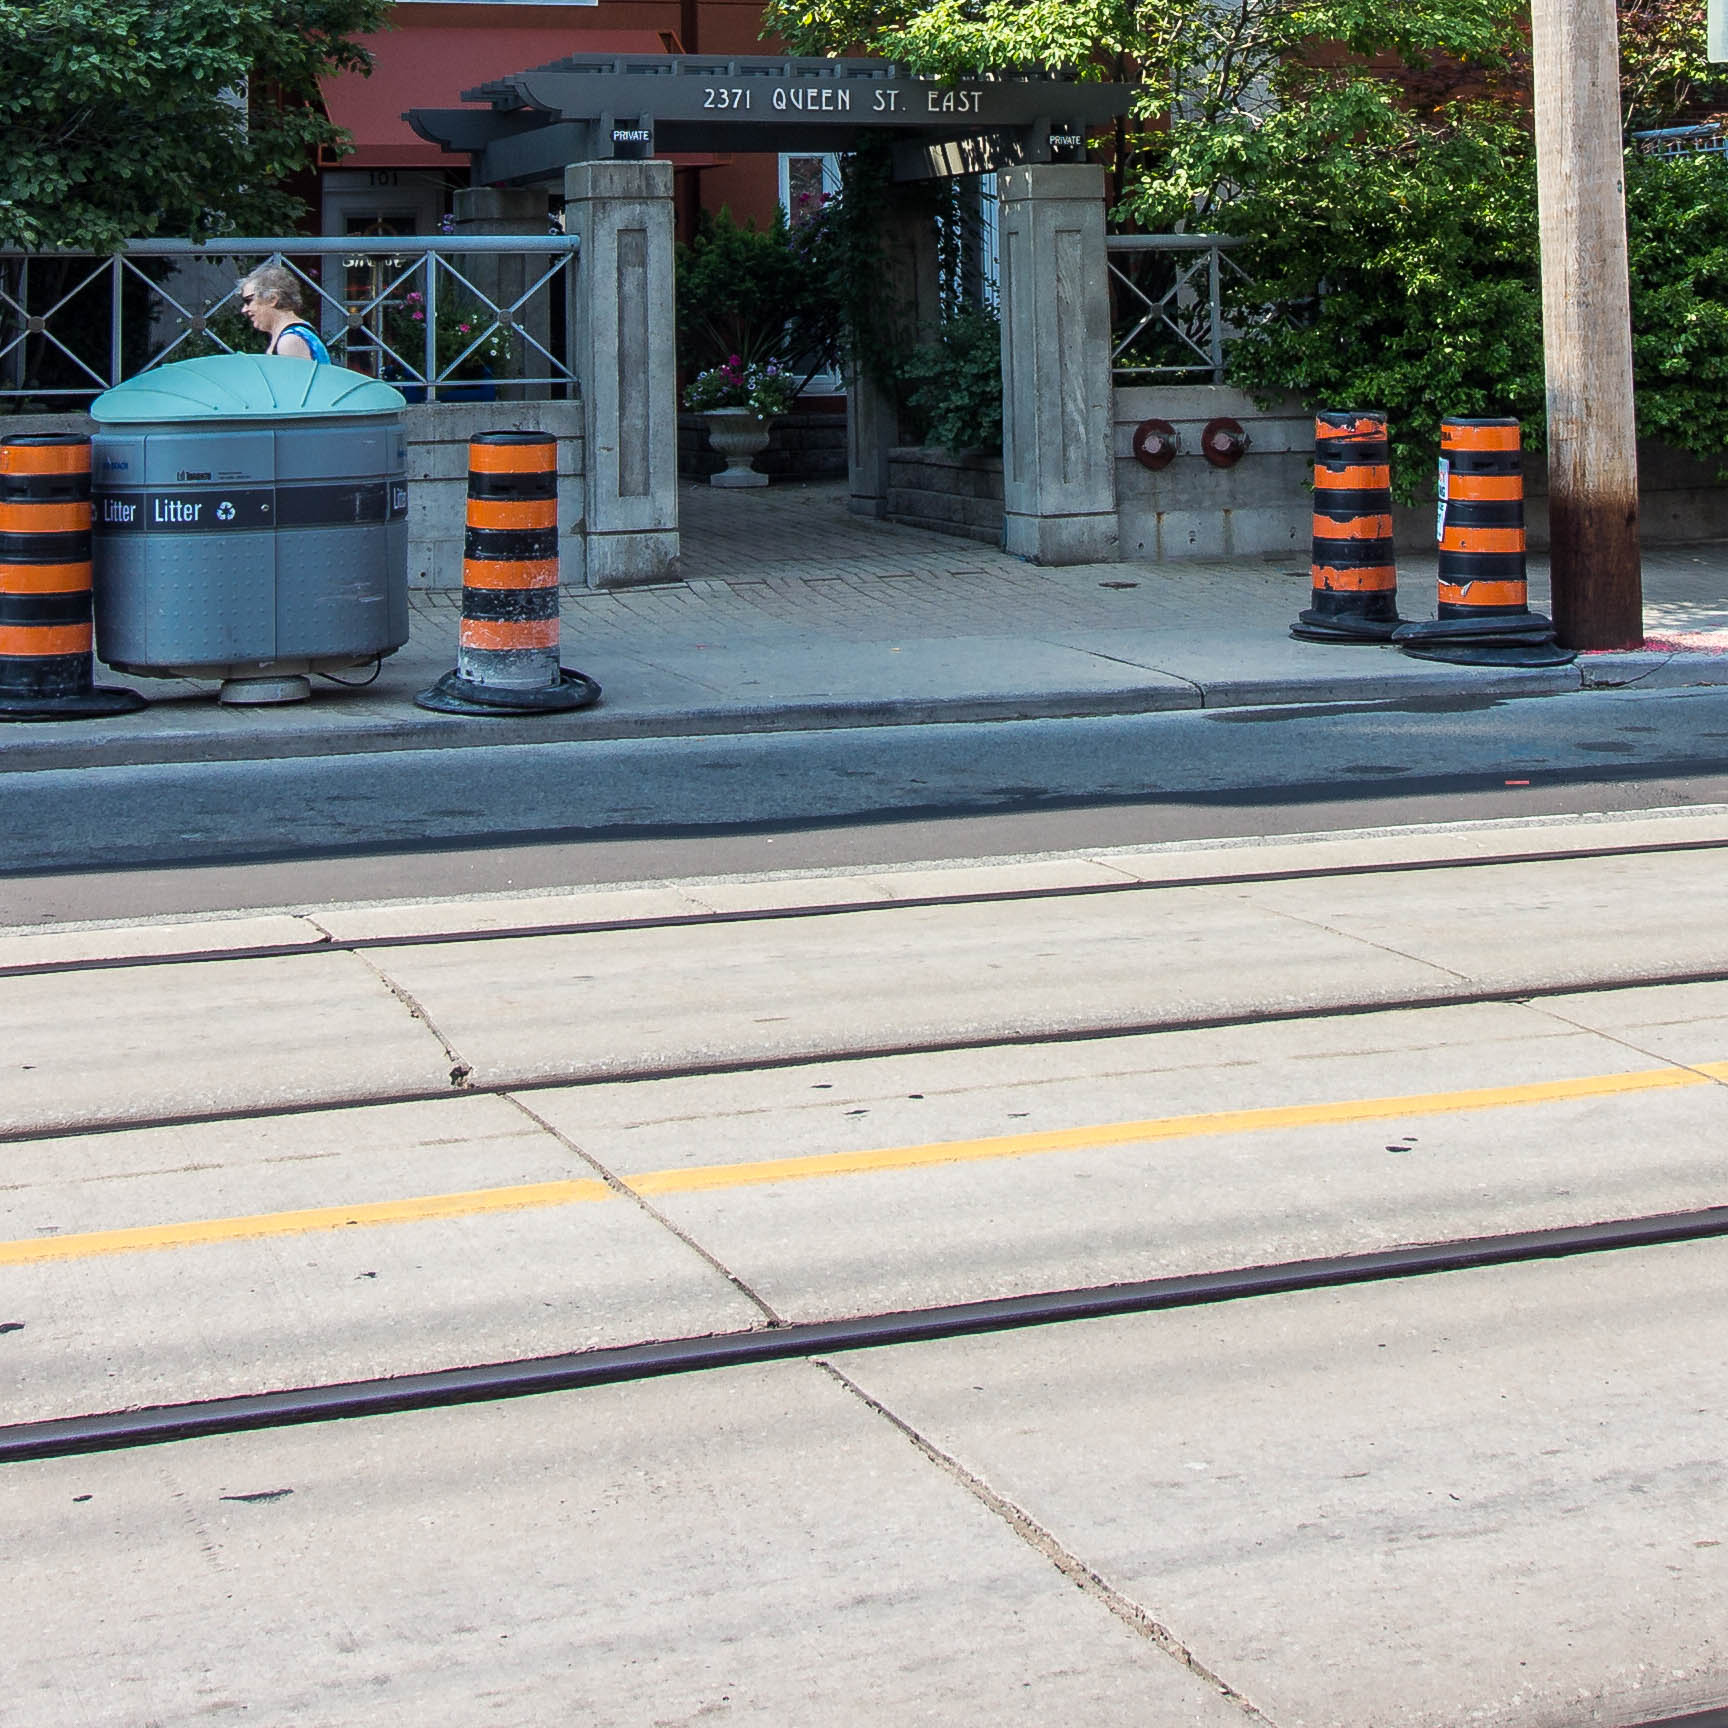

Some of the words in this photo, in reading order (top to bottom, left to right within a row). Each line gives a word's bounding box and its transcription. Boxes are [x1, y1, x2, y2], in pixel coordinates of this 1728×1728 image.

[703, 88, 751, 110] 2371
[772, 87, 850, 111] QUEEN
[873, 89, 907, 111] ST.
[928, 90, 983, 113] EAST
[613, 130, 649, 141] PRIVATE
[1049, 135, 1081, 145] PRIVATE
[369, 171, 399, 186] 101
[104, 499, 136, 522] Litter
[154, 498, 202, 522] Litter
